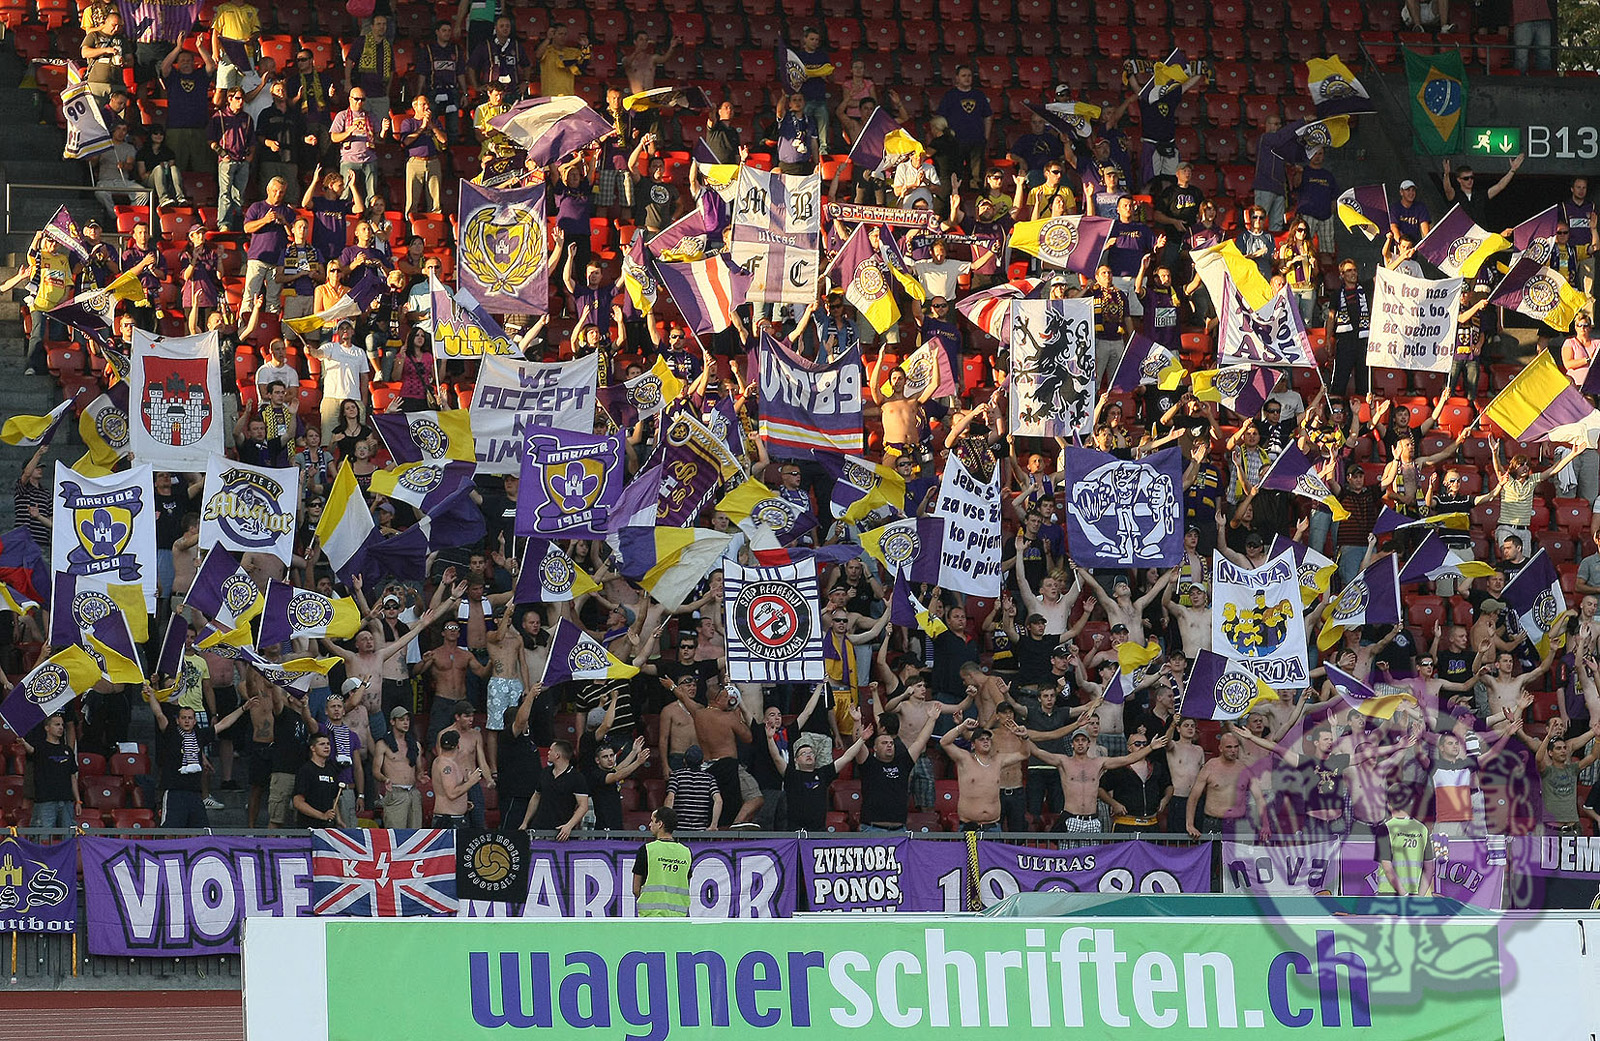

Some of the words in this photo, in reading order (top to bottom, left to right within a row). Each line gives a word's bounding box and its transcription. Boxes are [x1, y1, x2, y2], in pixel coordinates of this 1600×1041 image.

[66, 101, 86, 122] 90
[1528, 126, 1598, 159] B13
[739, 187, 767, 216] M
[790, 191, 813, 225] B
[841, 206, 928, 224] SLOVENIJA
[758, 230, 797, 246] ultras
[790, 259, 809, 288] C
[1426, 288, 1449, 299] nas
[518, 367, 562, 390] WE
[478, 386, 590, 412] ACCEPT
[76, 490, 134, 507] MARIBOR
[558, 511, 592, 528] 1960
[964, 503, 985, 522] vse
[950, 521, 966, 543] ko
[86, 558, 120, 573] 1960
[739, 588, 757, 607] STOP
[759, 584, 803, 607] REPRESIJI
[1402, 838, 1418, 849] 720
[662, 863, 679, 873] 719
[813, 846, 902, 875] ZVESTOBA,
[1018, 855, 1096, 871] ULTRAS
[1228, 856, 1329, 888] nova
[814, 875, 903, 904] PONOS,
[468, 927, 1373, 1041] wagnerschriften.ch
